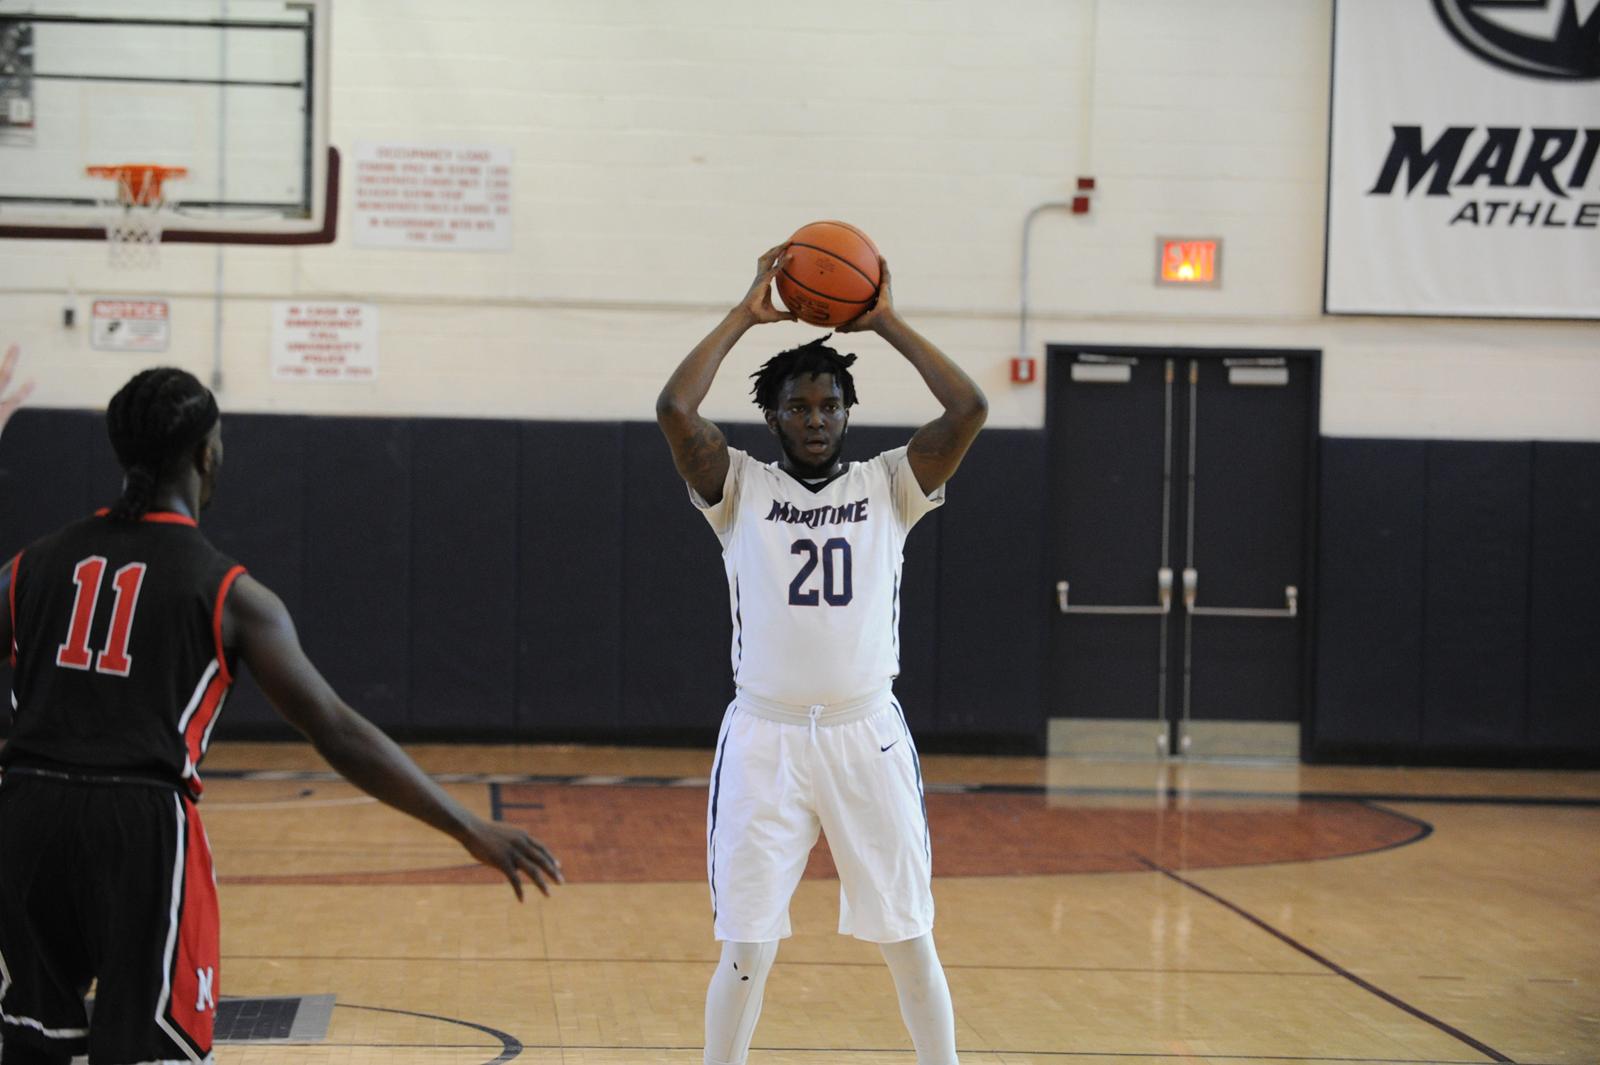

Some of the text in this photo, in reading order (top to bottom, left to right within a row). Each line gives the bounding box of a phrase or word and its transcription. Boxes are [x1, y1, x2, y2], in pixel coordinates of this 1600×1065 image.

[1449, 201, 1600, 228] ATHLE
[1163, 240, 1216, 281] EXIT
[765, 498, 869, 529] MARITIME
[788, 537, 853, 606] 20
[56, 555, 147, 677] 11
[196, 967, 214, 1011] N
